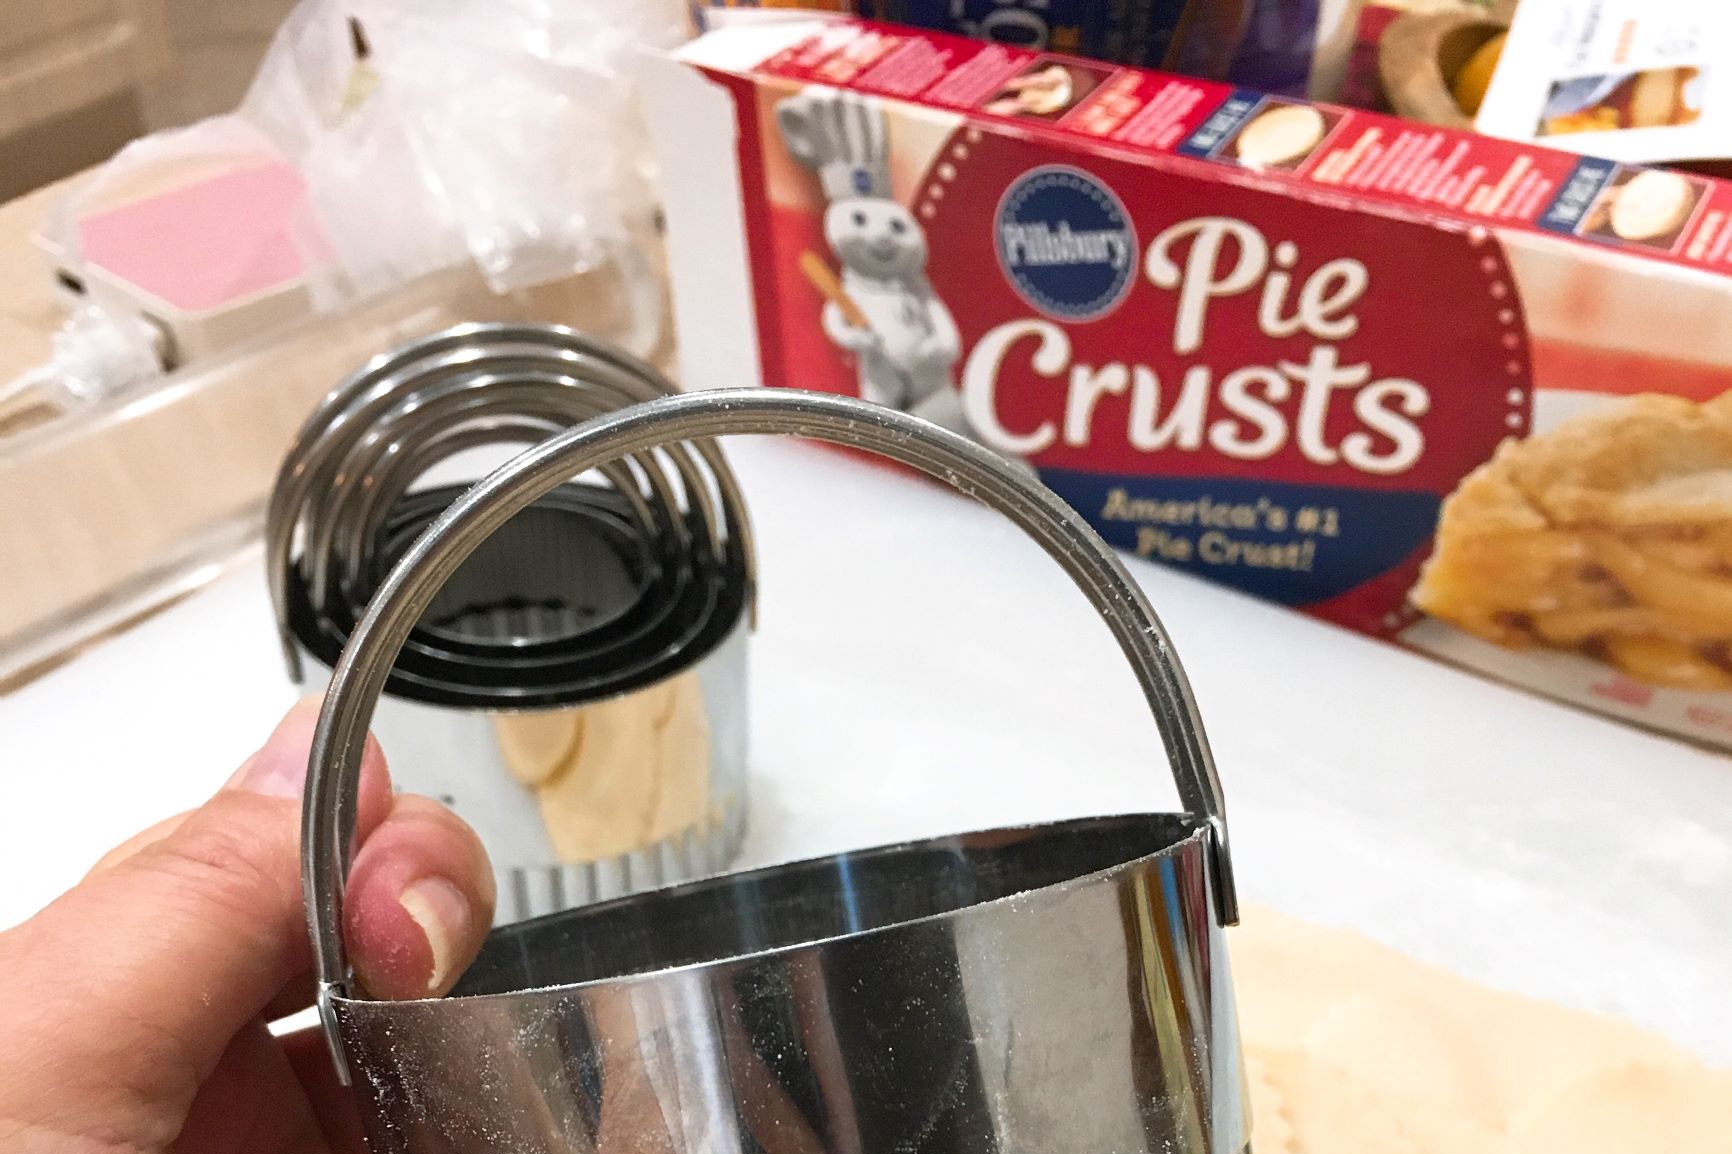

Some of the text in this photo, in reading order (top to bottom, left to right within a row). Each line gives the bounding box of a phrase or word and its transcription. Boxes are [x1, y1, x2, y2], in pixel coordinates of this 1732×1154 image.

[1003, 221, 1129, 268] Pillsbury
[1145, 215, 1369, 354] Pie
[962, 318, 1431, 475] Crusts
[1102, 488, 1340, 536] America's #1
[1136, 527, 1316, 572] Pie Crust!
